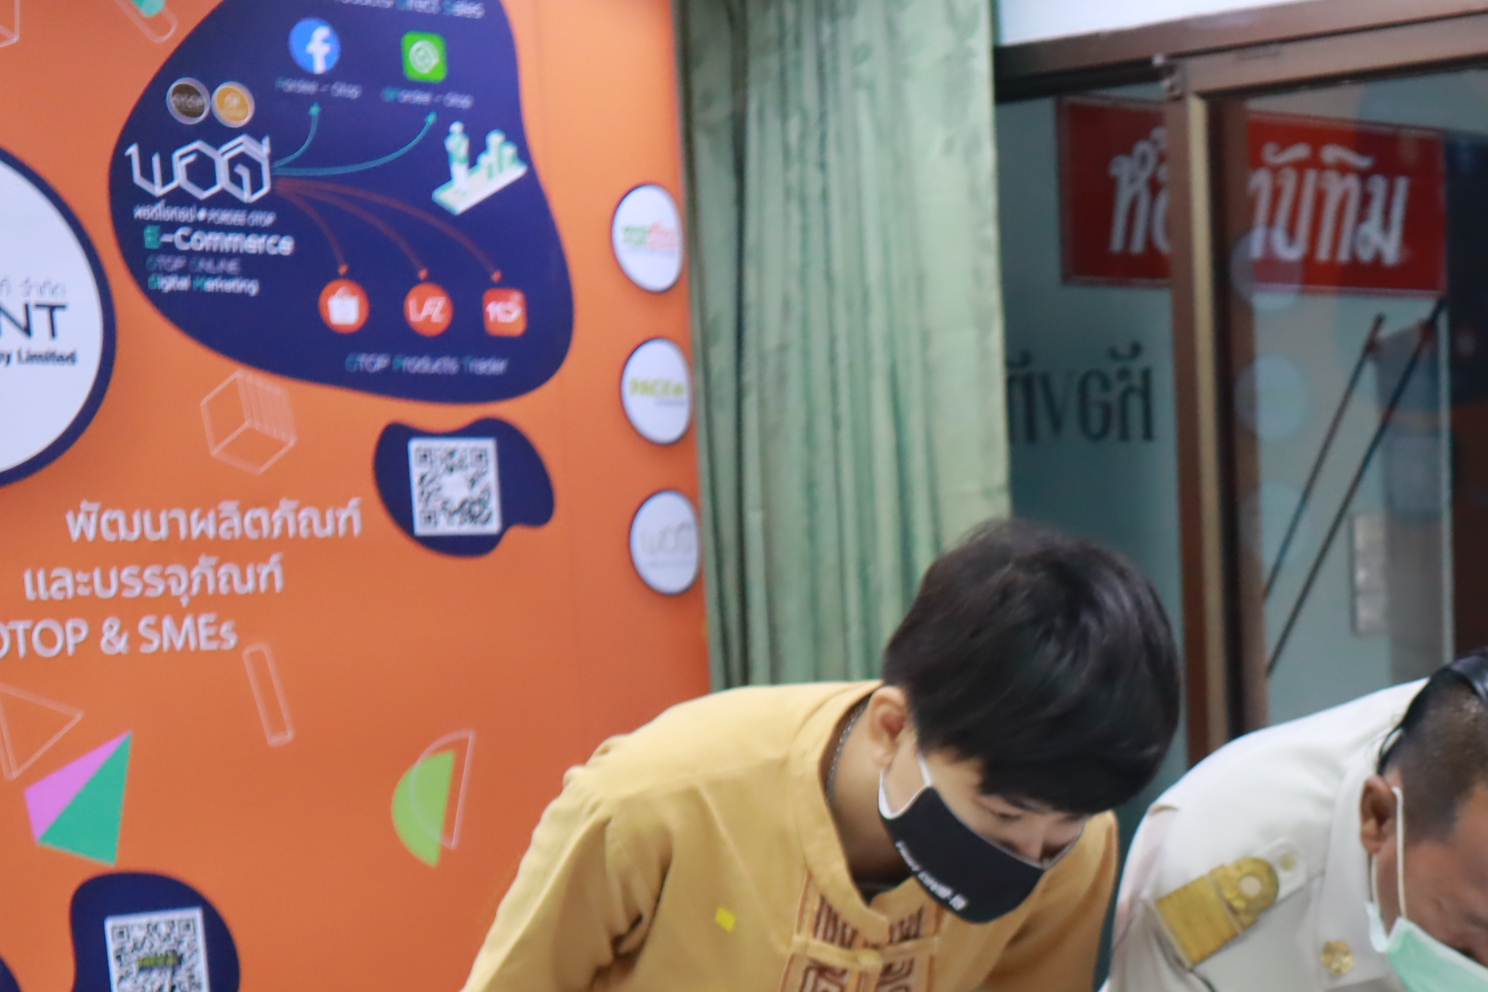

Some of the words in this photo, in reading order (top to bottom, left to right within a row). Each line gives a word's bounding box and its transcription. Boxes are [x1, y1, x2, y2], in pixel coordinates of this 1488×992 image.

[143, 224, 295, 256] E-Commerce
[65, 497, 363, 542] พัฒนาผลิตภัณฑ์
[23, 552, 284, 608] และบรรจุภัณฑ์
[99, 615, 129, 655] &
[137, 612, 239, 654] SMEs
